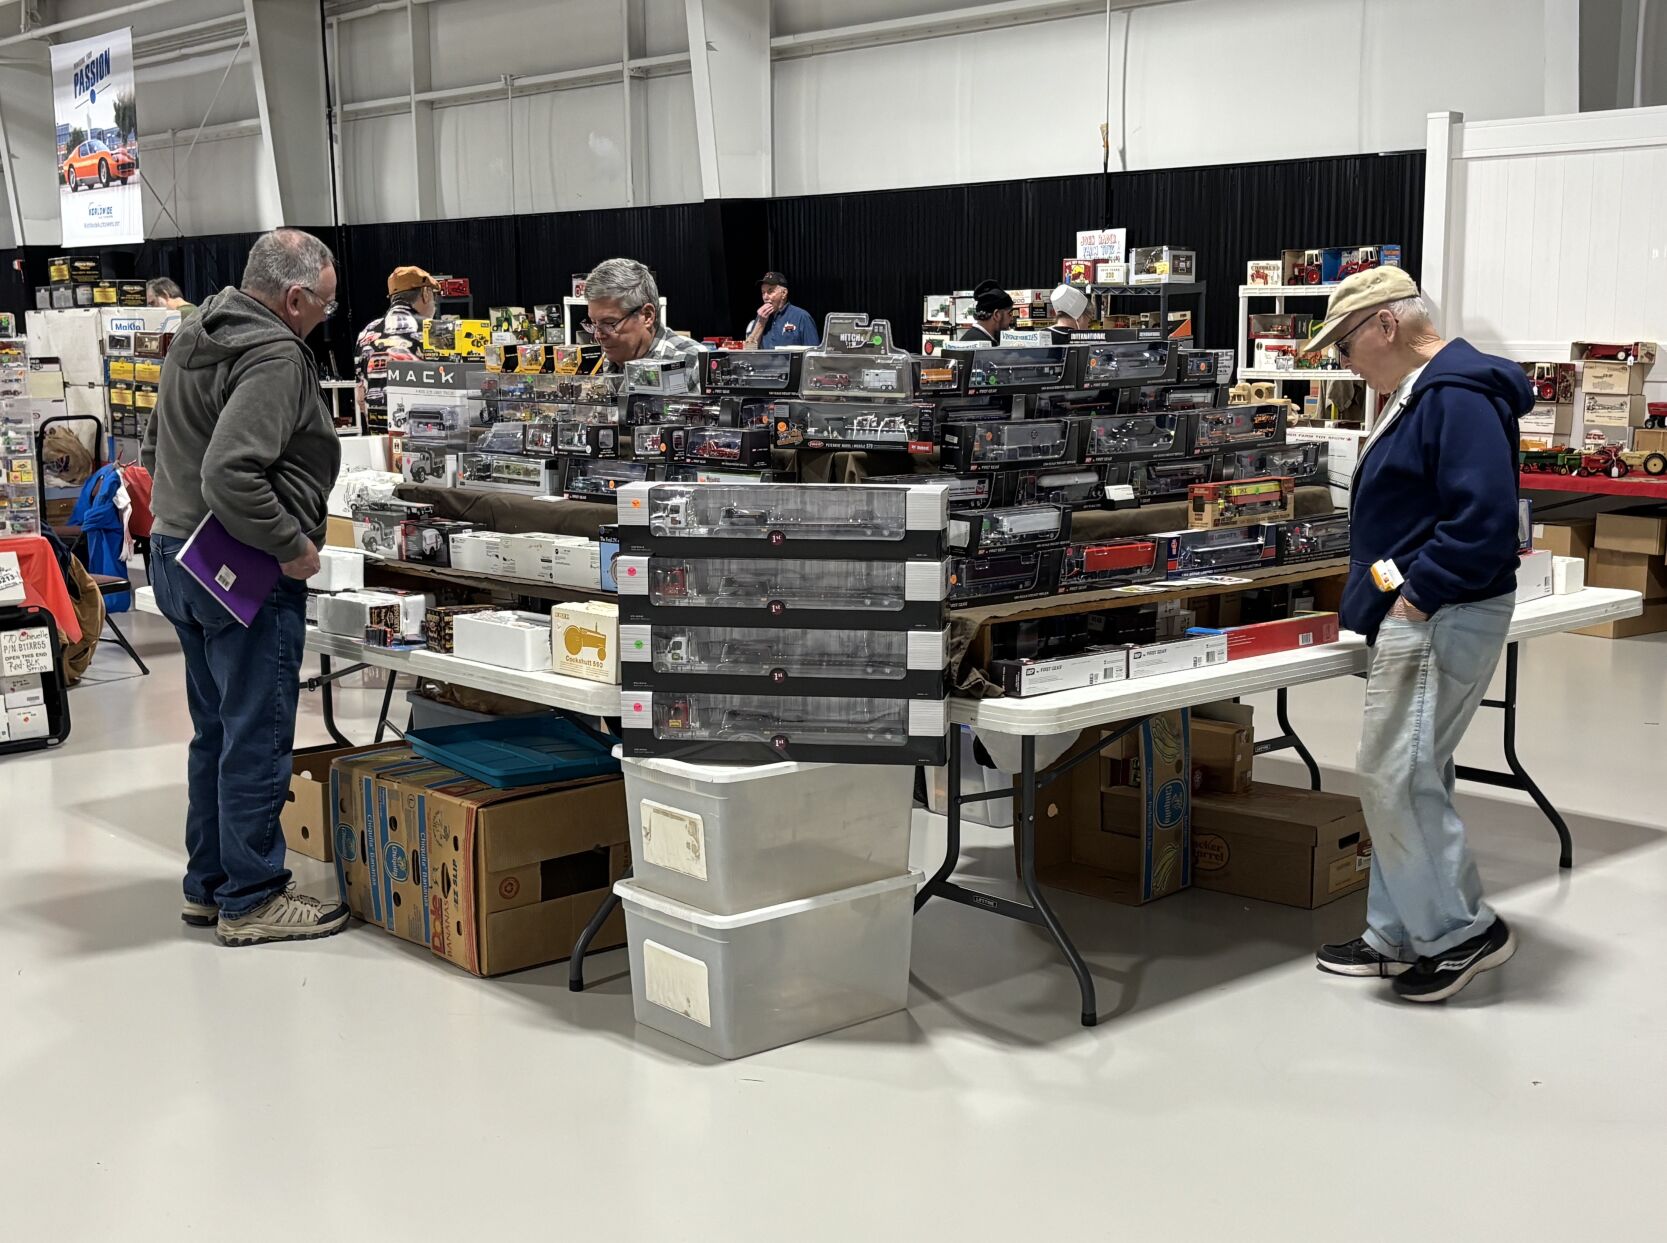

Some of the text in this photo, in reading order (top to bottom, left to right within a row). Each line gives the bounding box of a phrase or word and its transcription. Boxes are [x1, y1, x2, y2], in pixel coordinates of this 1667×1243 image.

[74, 47, 110, 99] PASSION
[387, 369, 455, 384] MACK
[565, 655, 592, 666] Cockshutt
[1165, 785, 1173, 824] Chiquita
[369, 852, 377, 886] Bananas
[431, 894, 445, 955] Dole
[444, 900, 453, 957] BANANAS
